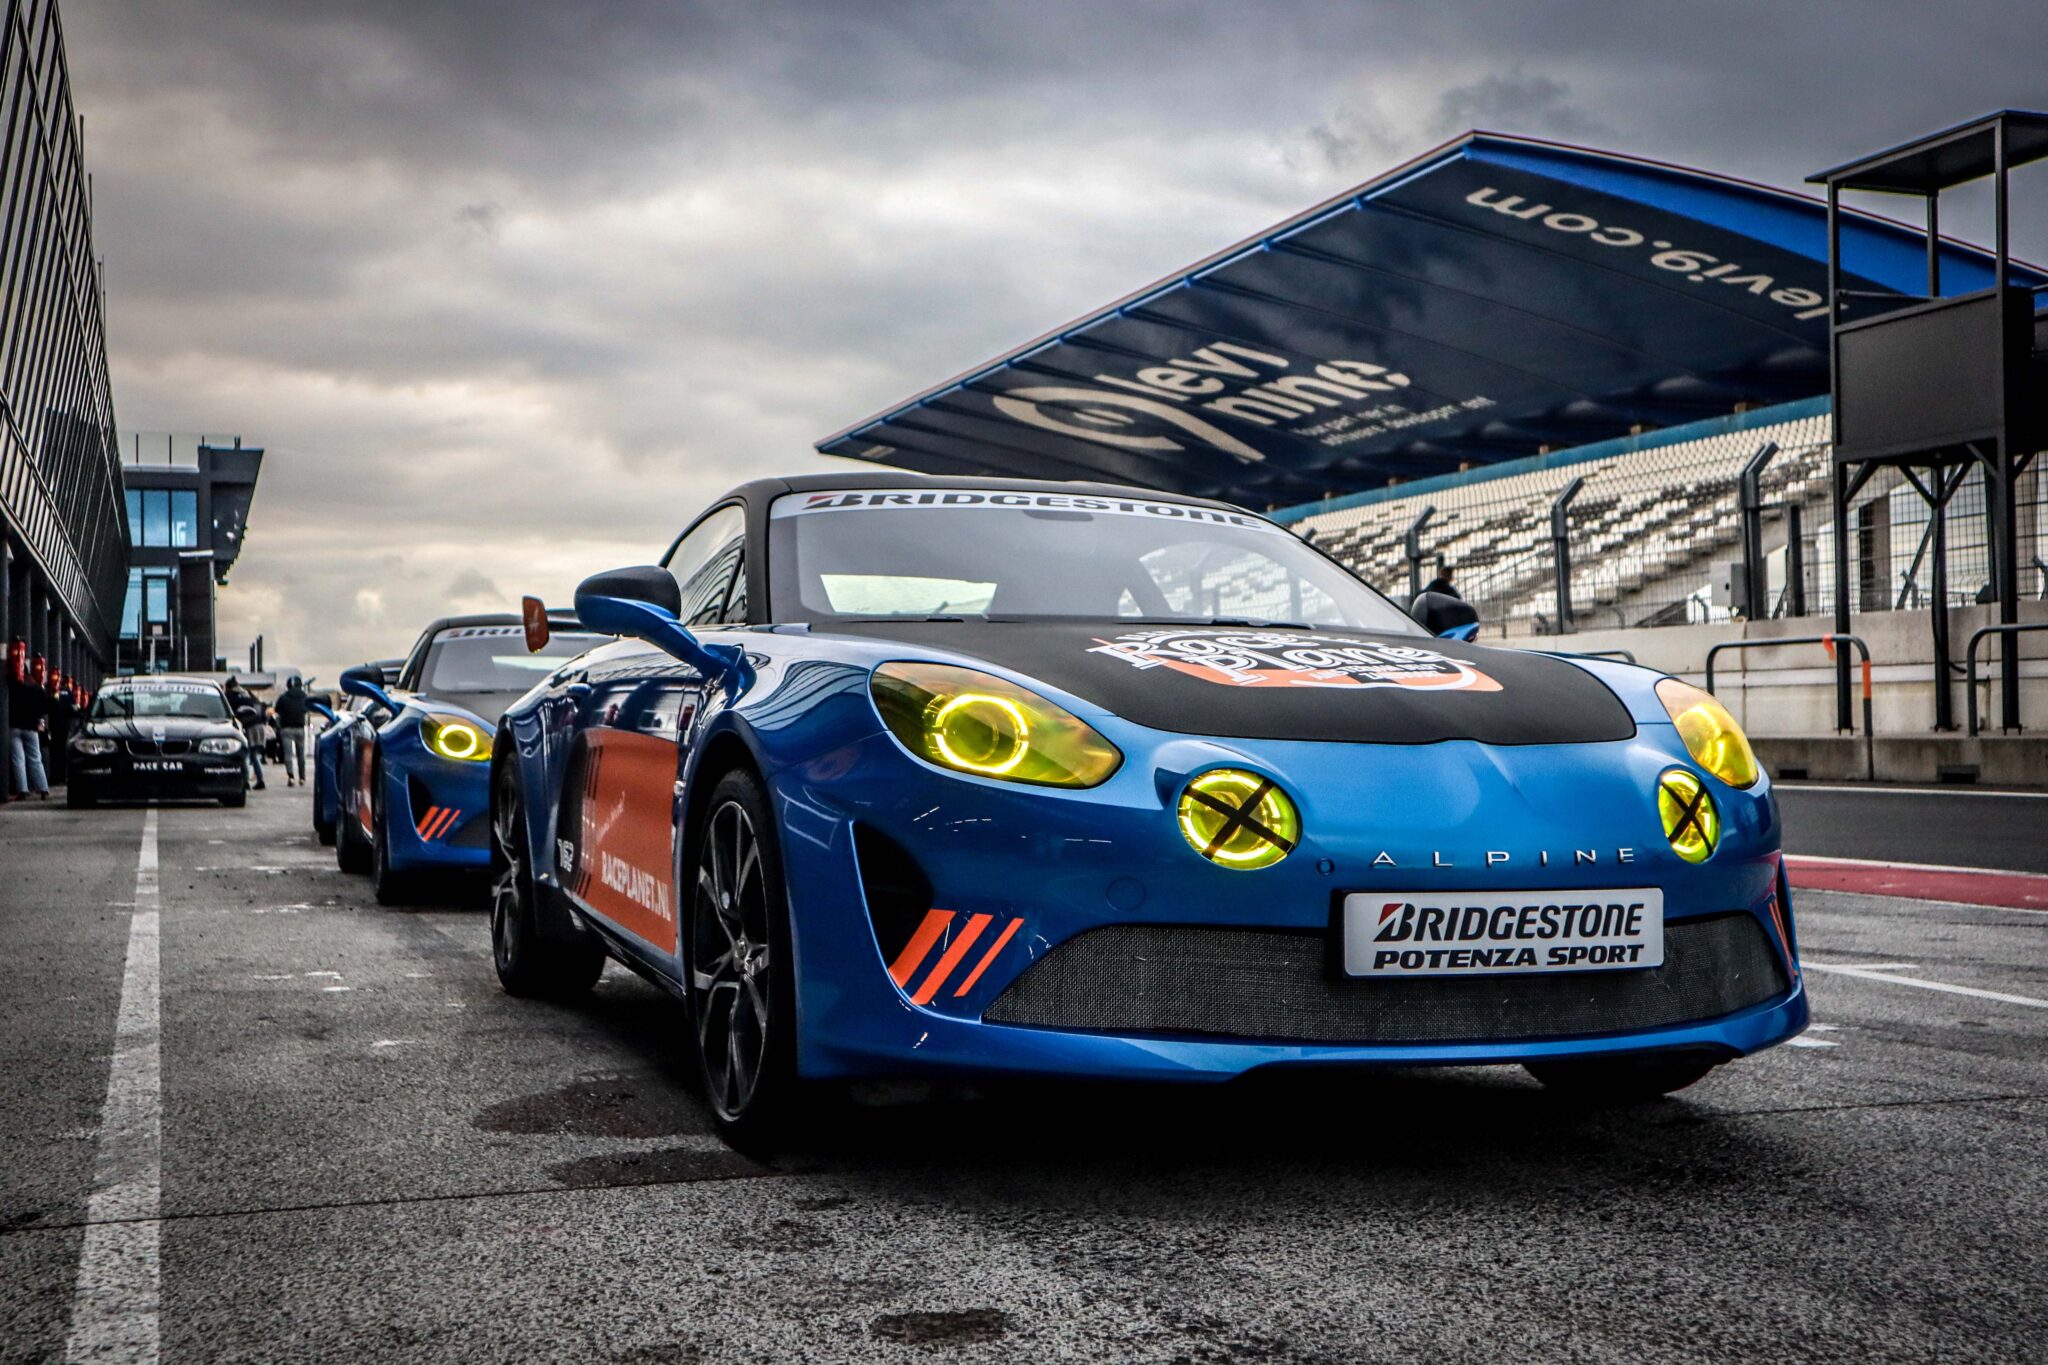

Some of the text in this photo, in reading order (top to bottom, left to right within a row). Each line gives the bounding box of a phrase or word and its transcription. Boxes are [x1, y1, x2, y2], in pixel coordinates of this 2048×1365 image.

[1466, 187, 1849, 320] levi9.com
[1095, 341, 1289, 401] levi
[802, 493, 1263, 529] BRIDGESTONE
[1086, 633, 1320, 670] Race
[133, 762, 183, 771] PACE CAR
[1371, 848, 1634, 868] ALPINE
[601, 851, 671, 922] RACEPLANET.NL
[1373, 903, 1645, 942] BRIDGESTONE
[1373, 944, 1645, 969] POTENZA SPORT
